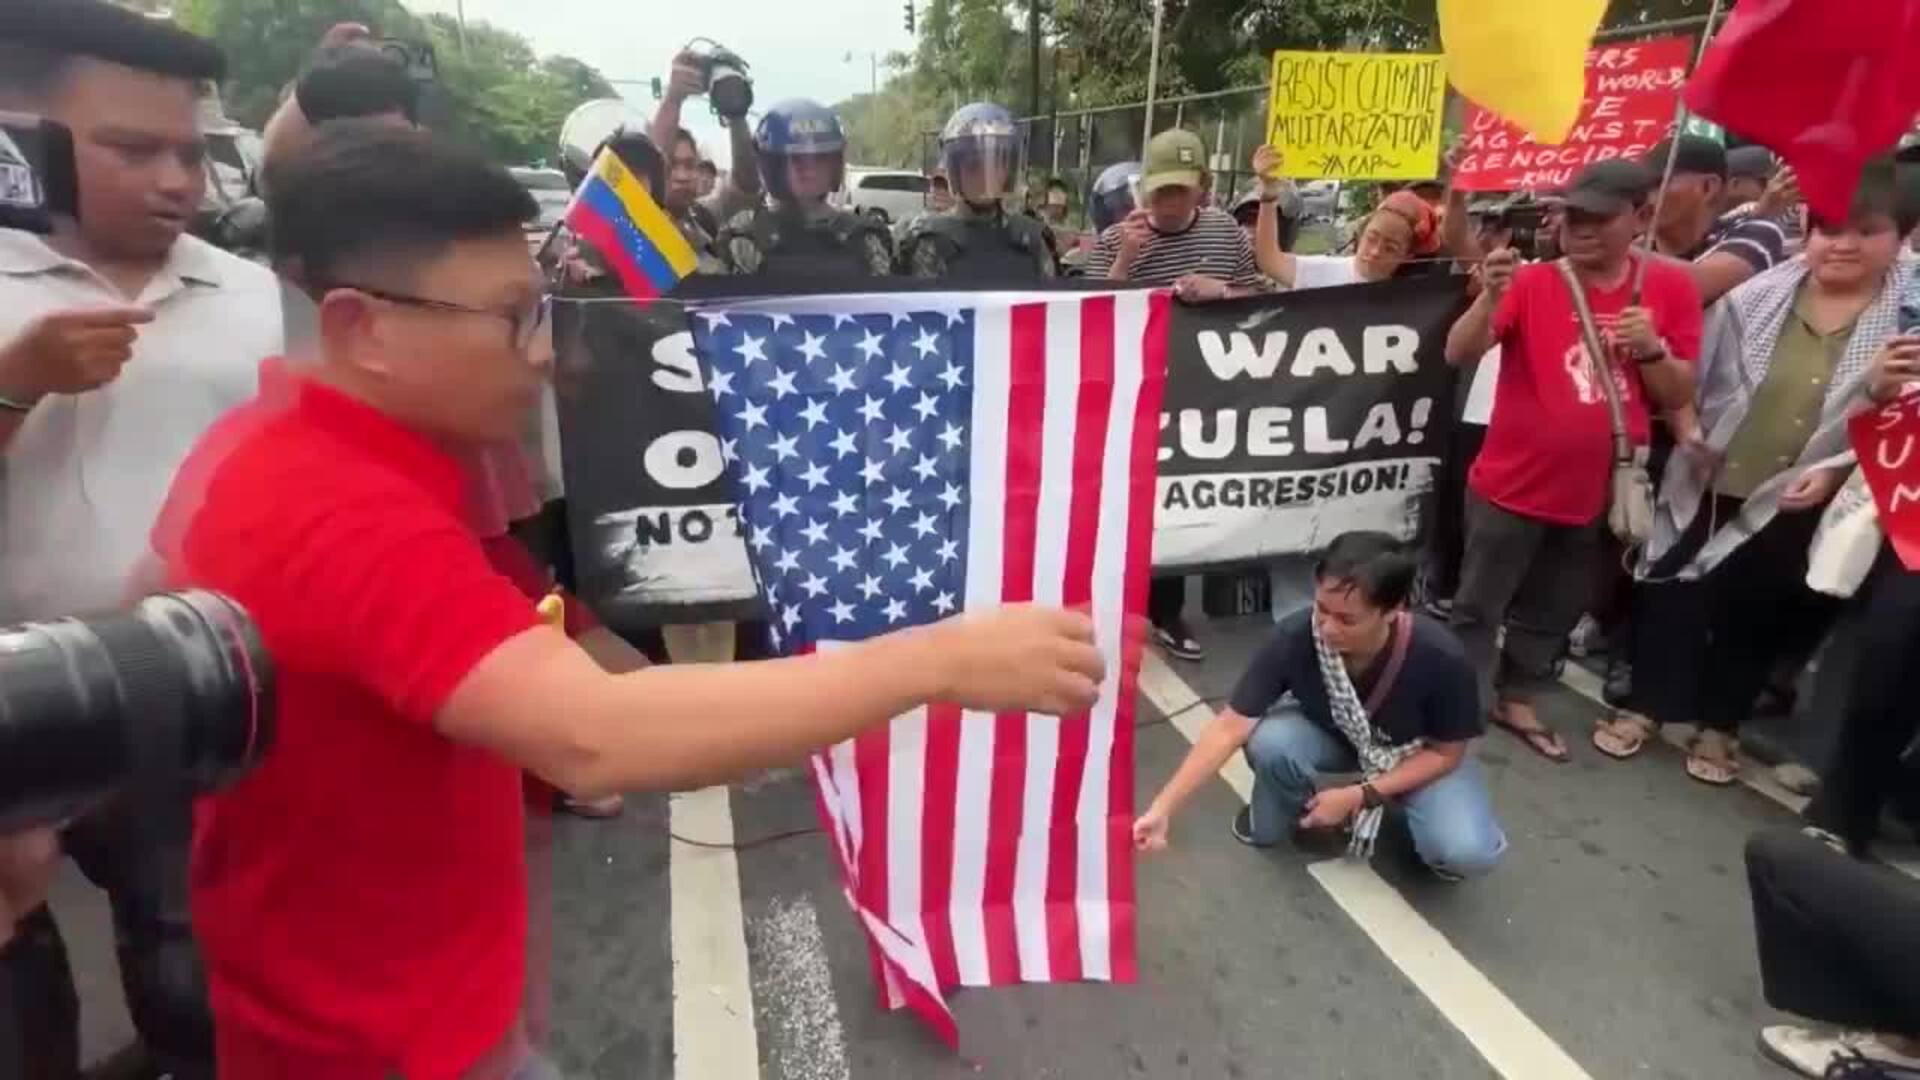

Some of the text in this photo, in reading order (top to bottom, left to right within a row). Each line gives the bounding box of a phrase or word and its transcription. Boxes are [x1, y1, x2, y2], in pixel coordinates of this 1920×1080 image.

[1276, 57, 1439, 113] RESIST CLIMATE
[1270, 112, 1435, 152] MILITARIZATION
[1197, 324, 1420, 380] WAR
[635, 510, 713, 546] NO
[1162, 463, 1411, 510] AGGRESSION!
